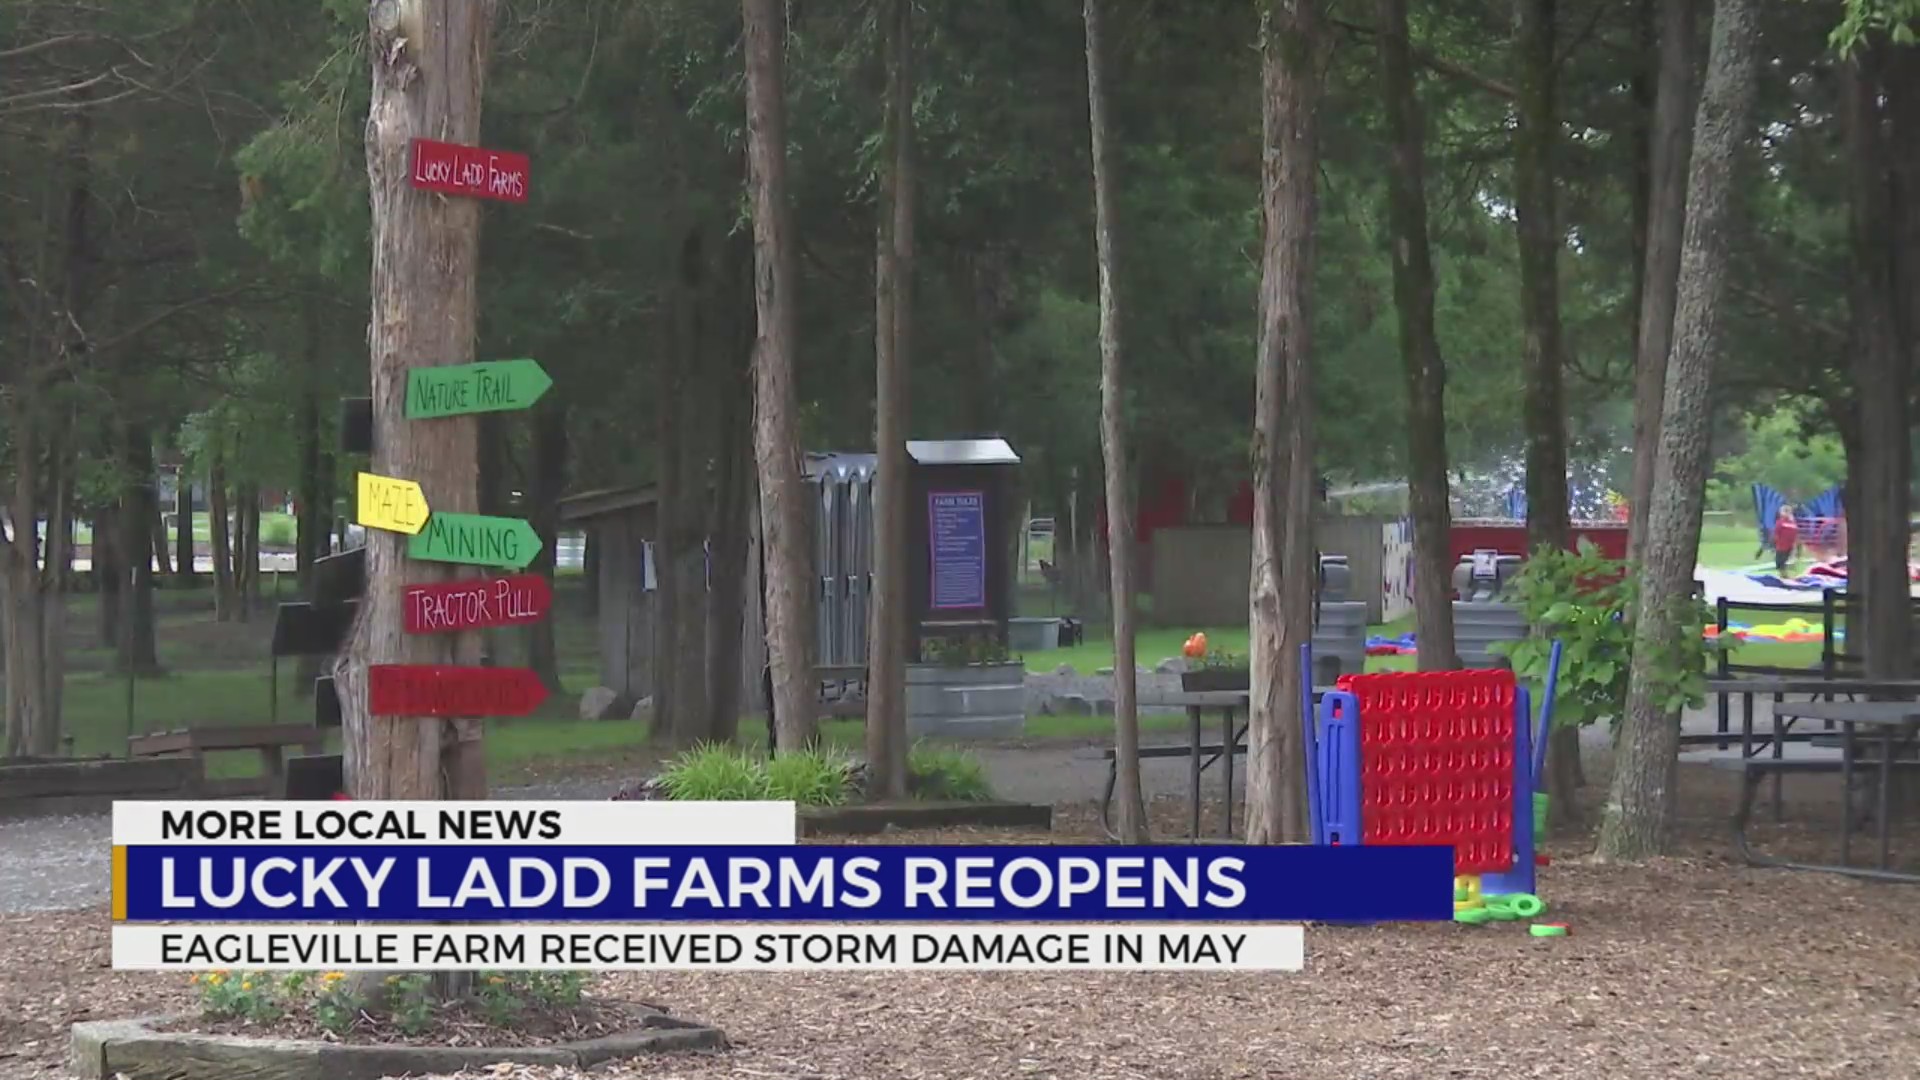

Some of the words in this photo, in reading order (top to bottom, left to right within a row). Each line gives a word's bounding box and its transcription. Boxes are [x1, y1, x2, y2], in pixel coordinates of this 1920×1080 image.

[415, 141, 451, 182] LUCKY
[453, 155, 484, 186] LADD
[489, 155, 524, 197] FARMS
[415, 379, 469, 411] NATURE
[475, 369, 516, 404] TRAIL
[368, 482, 416, 526] MAZE
[426, 516, 518, 560] MINING
[408, 590, 492, 629] TRACTOR
[495, 579, 537, 620] PULL
